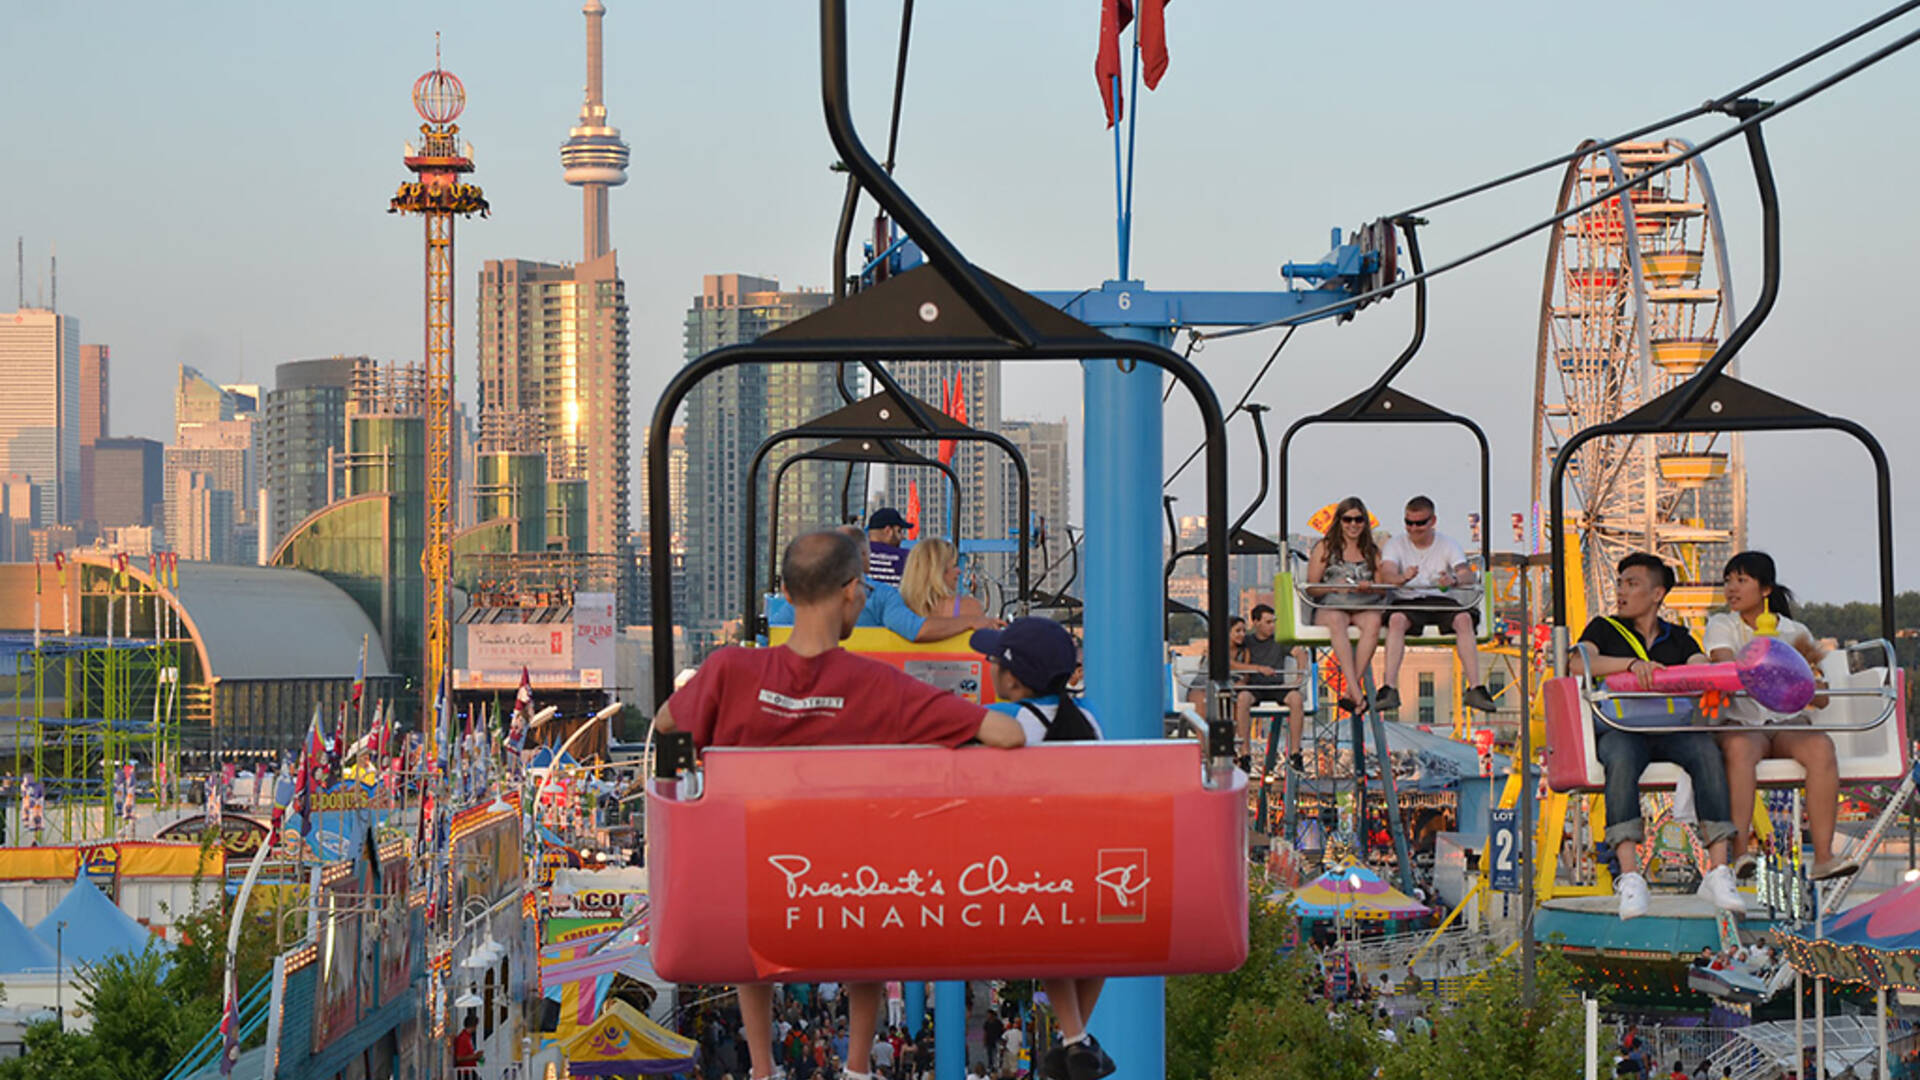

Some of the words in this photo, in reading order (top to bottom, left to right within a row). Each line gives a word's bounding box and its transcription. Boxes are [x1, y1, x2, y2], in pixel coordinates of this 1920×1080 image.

[1118, 291, 1131, 310] 6
[1493, 812, 1514, 821] LOT
[165, 829, 263, 852] PIZA
[1496, 828, 1513, 870] 2
[768, 855, 944, 898] President's
[959, 855, 1074, 895] Choice
[786, 902, 1074, 929] FINANCIAL
